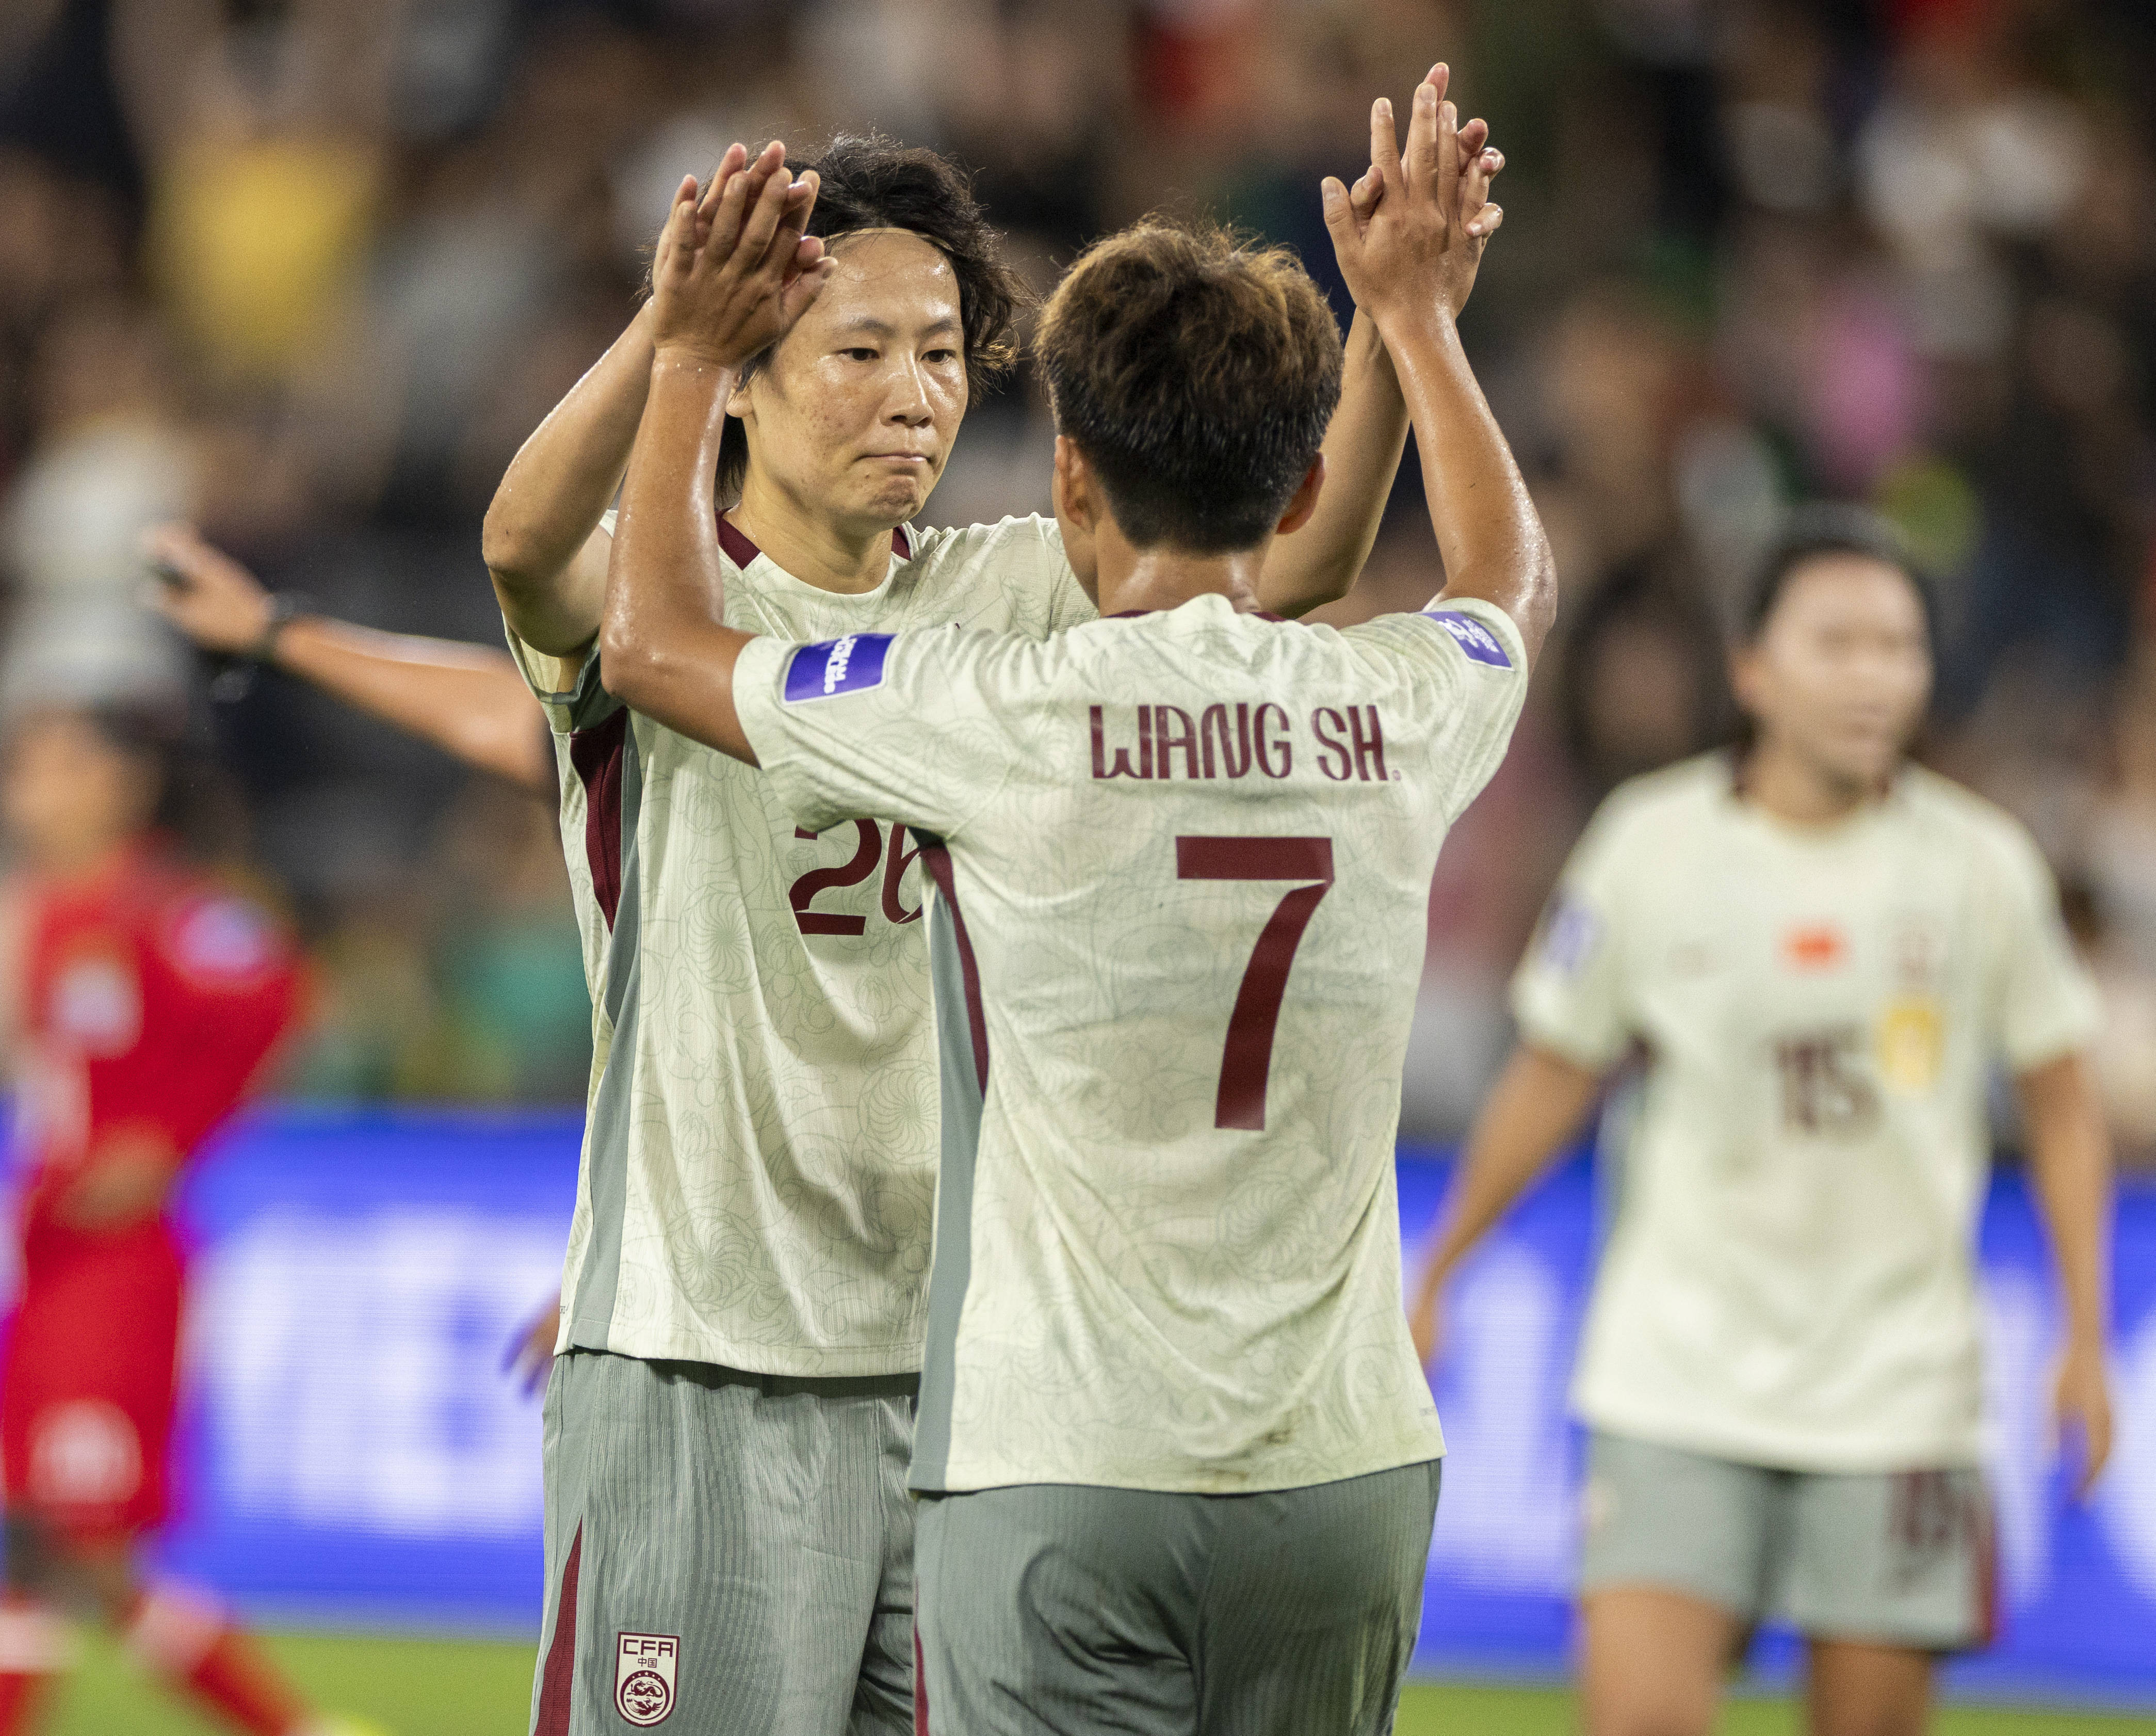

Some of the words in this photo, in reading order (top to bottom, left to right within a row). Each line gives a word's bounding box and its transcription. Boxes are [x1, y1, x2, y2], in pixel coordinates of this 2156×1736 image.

[1089, 702, 1292, 779] WANG
[1310, 705, 1402, 781] SH.
[1175, 835, 1335, 1131] 7
[623, 1638, 673, 1658] CFA
[638, 1657, 657, 1668] 中国
